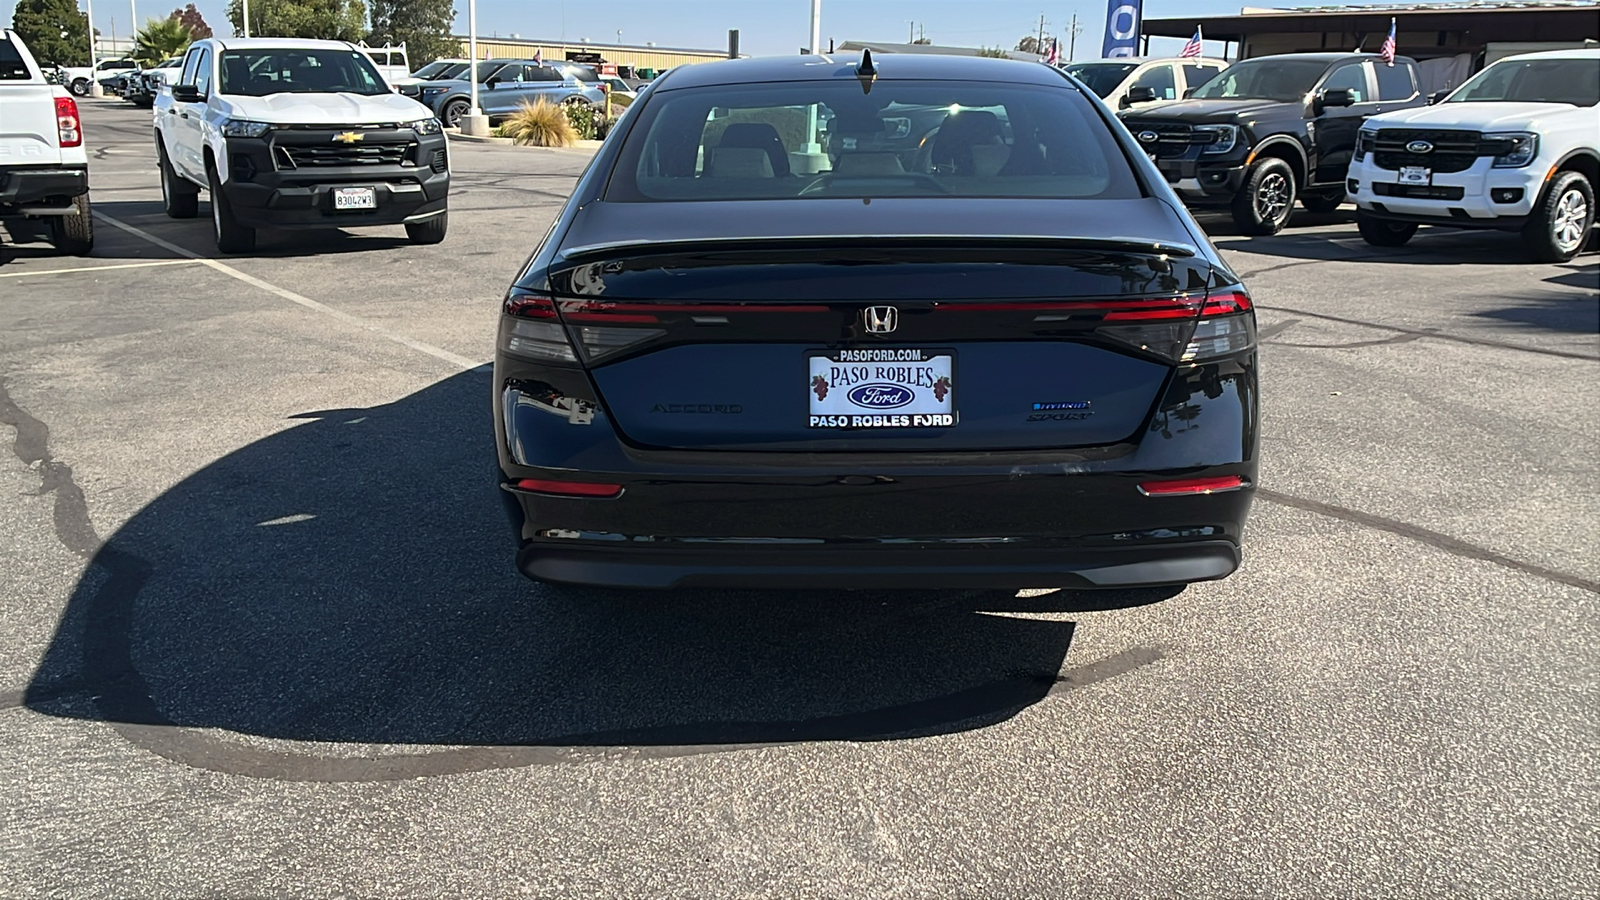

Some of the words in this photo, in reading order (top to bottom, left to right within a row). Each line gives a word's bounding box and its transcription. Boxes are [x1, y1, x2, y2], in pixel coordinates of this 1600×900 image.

[840, 350, 921, 361] PASOFORD.COM
[830, 367, 868, 388] PASO
[875, 367, 933, 388] ROBLES
[861, 387, 902, 404] Ford
[649, 403, 743, 414] ACCORD
[810, 416, 848, 427] PASO
[852, 416, 910, 427] ROBLES
[914, 415, 953, 426] FORD
